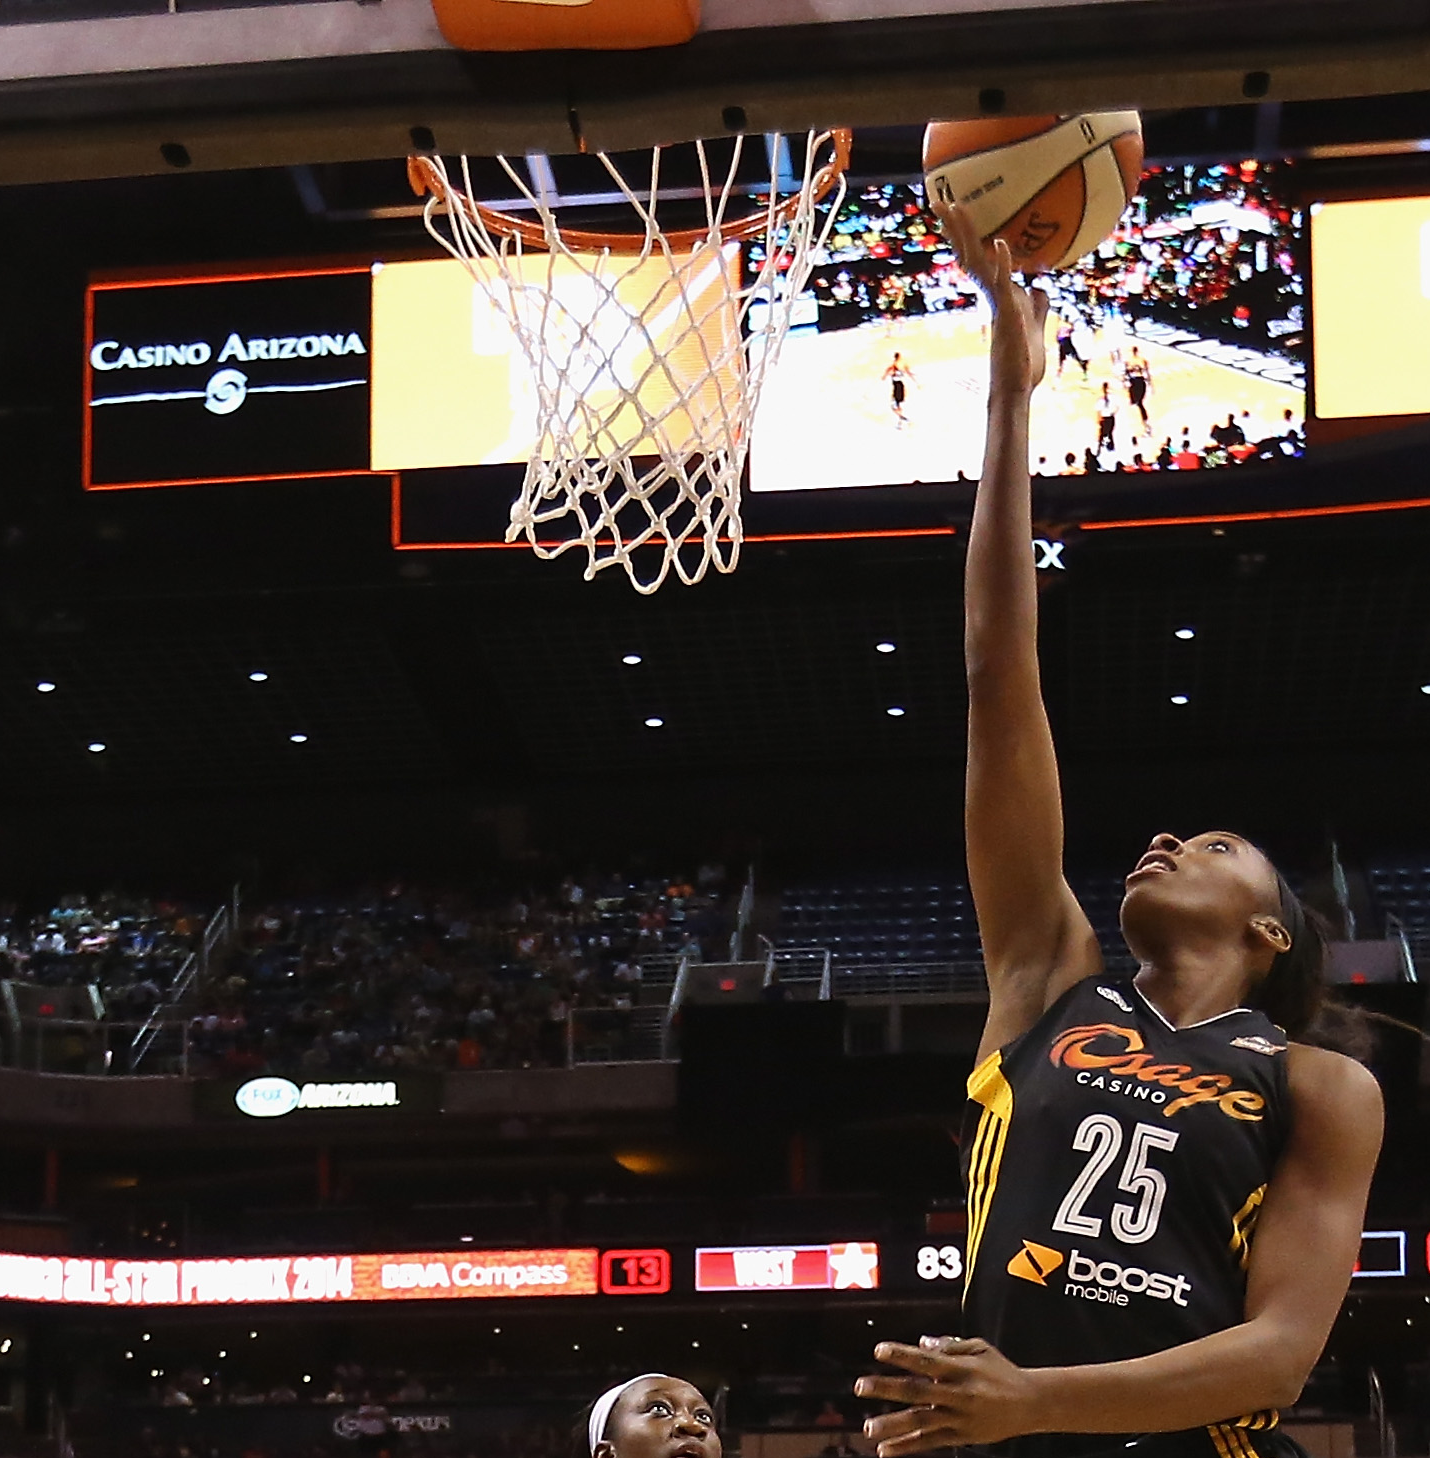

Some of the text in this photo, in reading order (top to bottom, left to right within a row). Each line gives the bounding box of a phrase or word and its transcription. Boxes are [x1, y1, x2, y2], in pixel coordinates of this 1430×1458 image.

[90, 332, 367, 371] CASINO ARIZONA
[1076, 1071, 1167, 1105] CASINO
[1052, 1113, 1180, 1245] 25
[622, 1256, 661, 1286] 13
[917, 1247, 963, 1280] 83
[1067, 1249, 1192, 1307] boost
[1064, 1283, 1130, 1307] mobile
